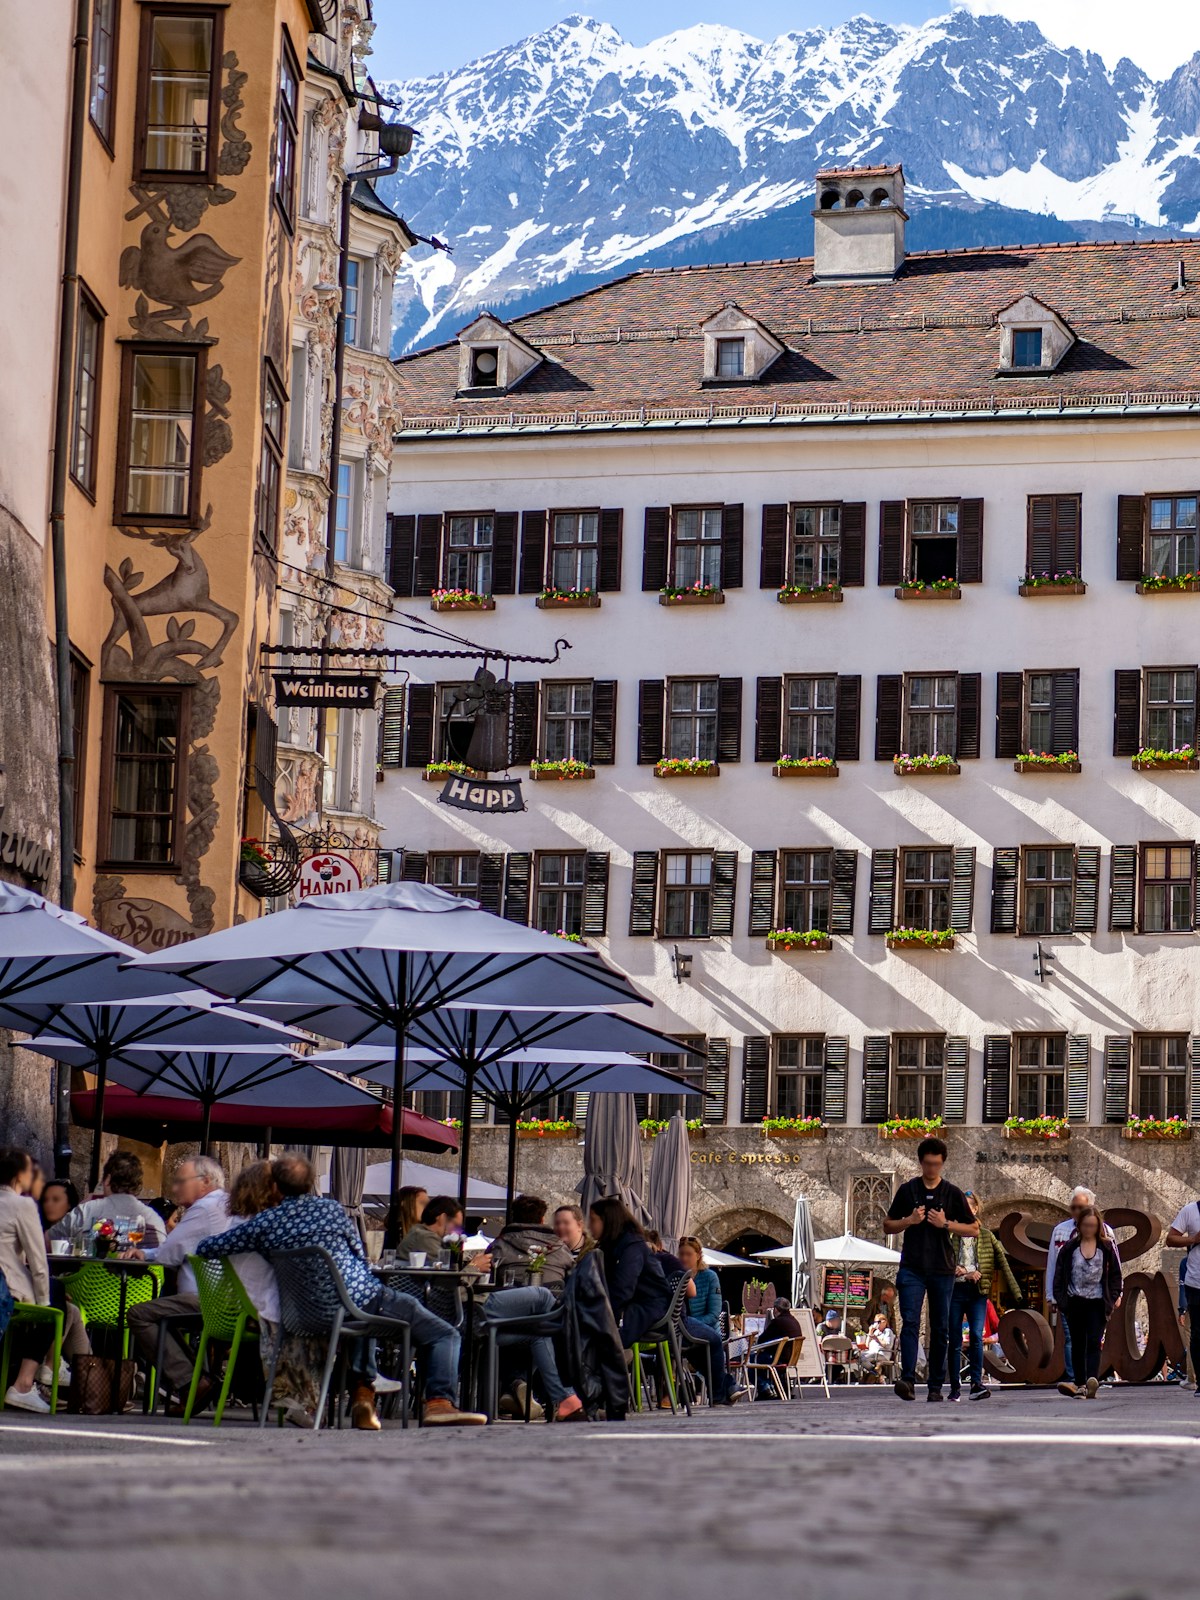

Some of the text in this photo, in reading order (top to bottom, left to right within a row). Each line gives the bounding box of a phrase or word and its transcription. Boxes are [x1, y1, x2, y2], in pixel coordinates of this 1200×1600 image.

[281, 678, 369, 698] Weinhaus
[448, 779, 516, 808] Happ
[690, 1151, 801, 1165] Cafe Espresso
